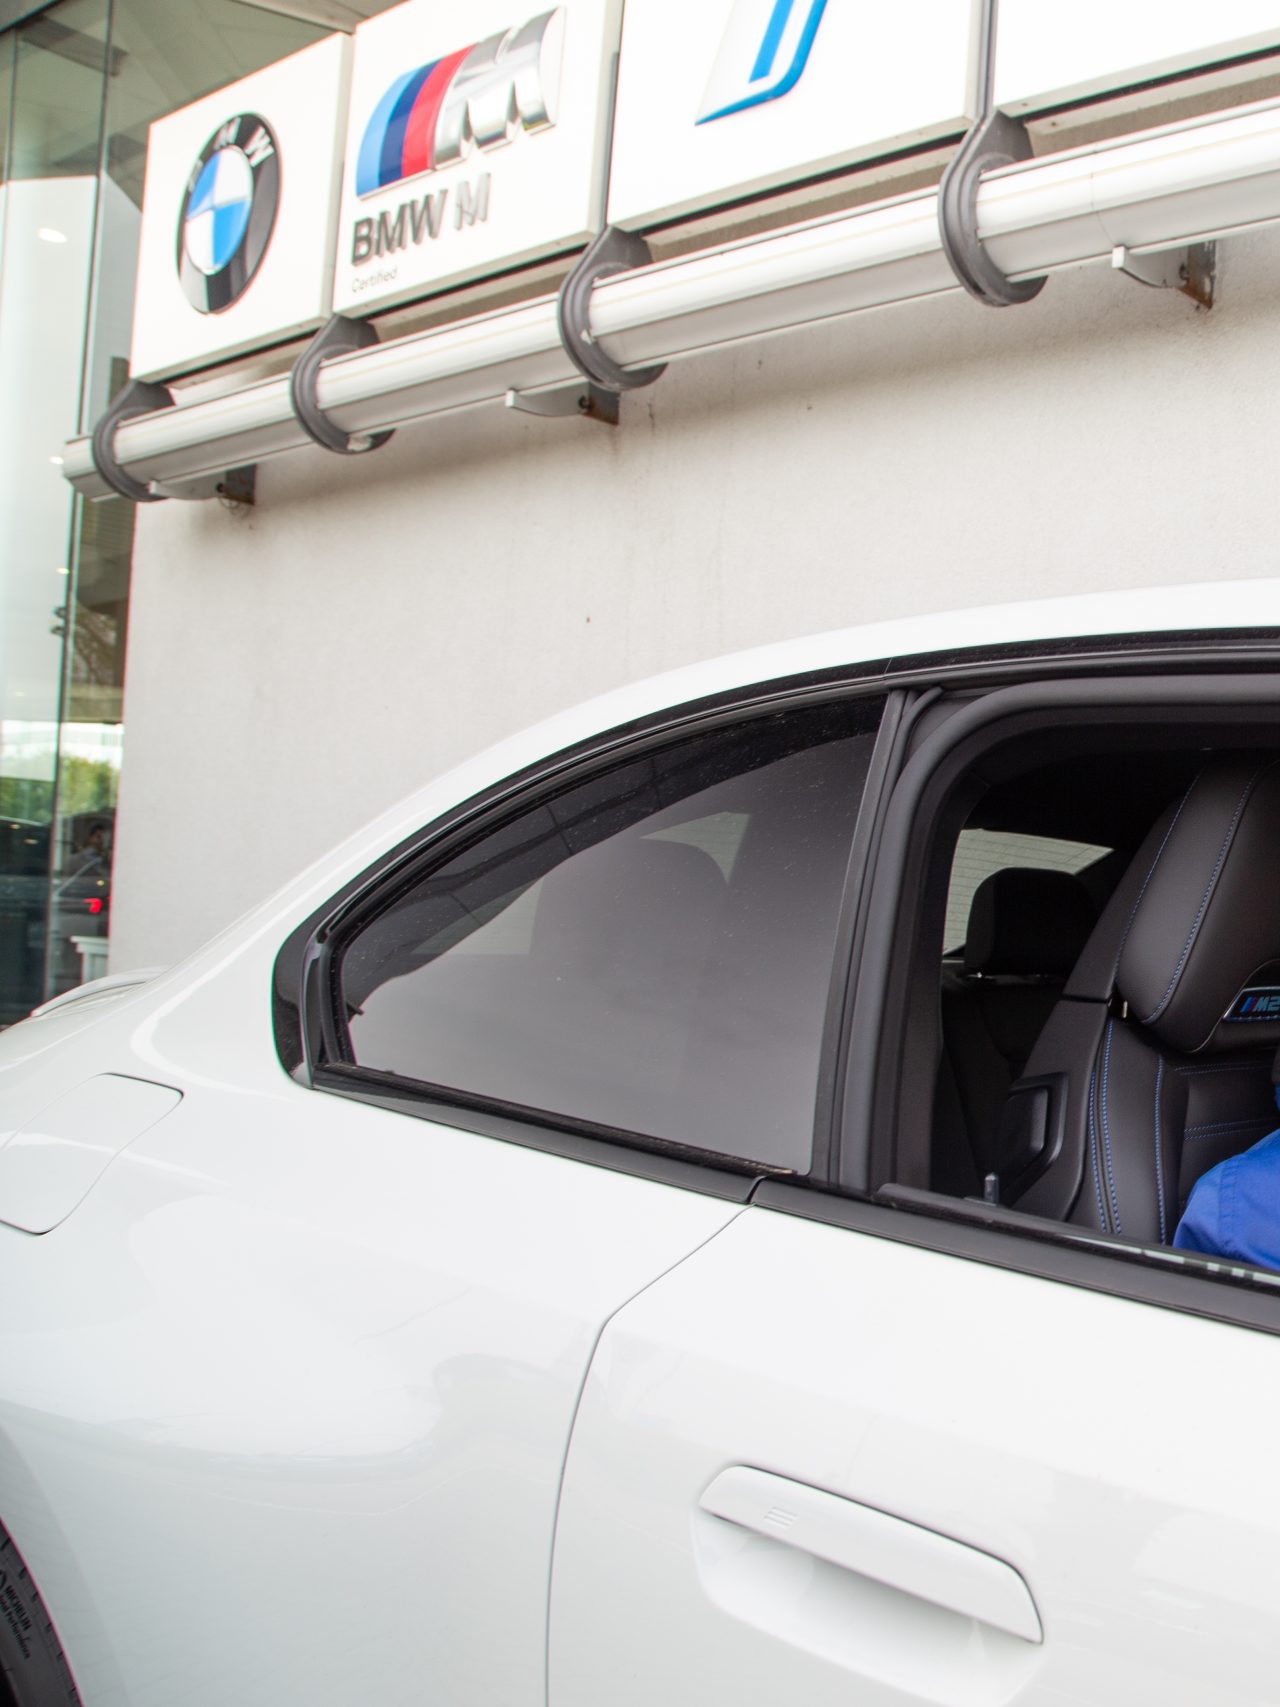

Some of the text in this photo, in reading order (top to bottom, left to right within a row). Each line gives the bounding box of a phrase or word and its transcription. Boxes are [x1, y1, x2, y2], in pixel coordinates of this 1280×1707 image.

[351, 172, 491, 267] BMW M
[351, 264, 398, 293] Certified
